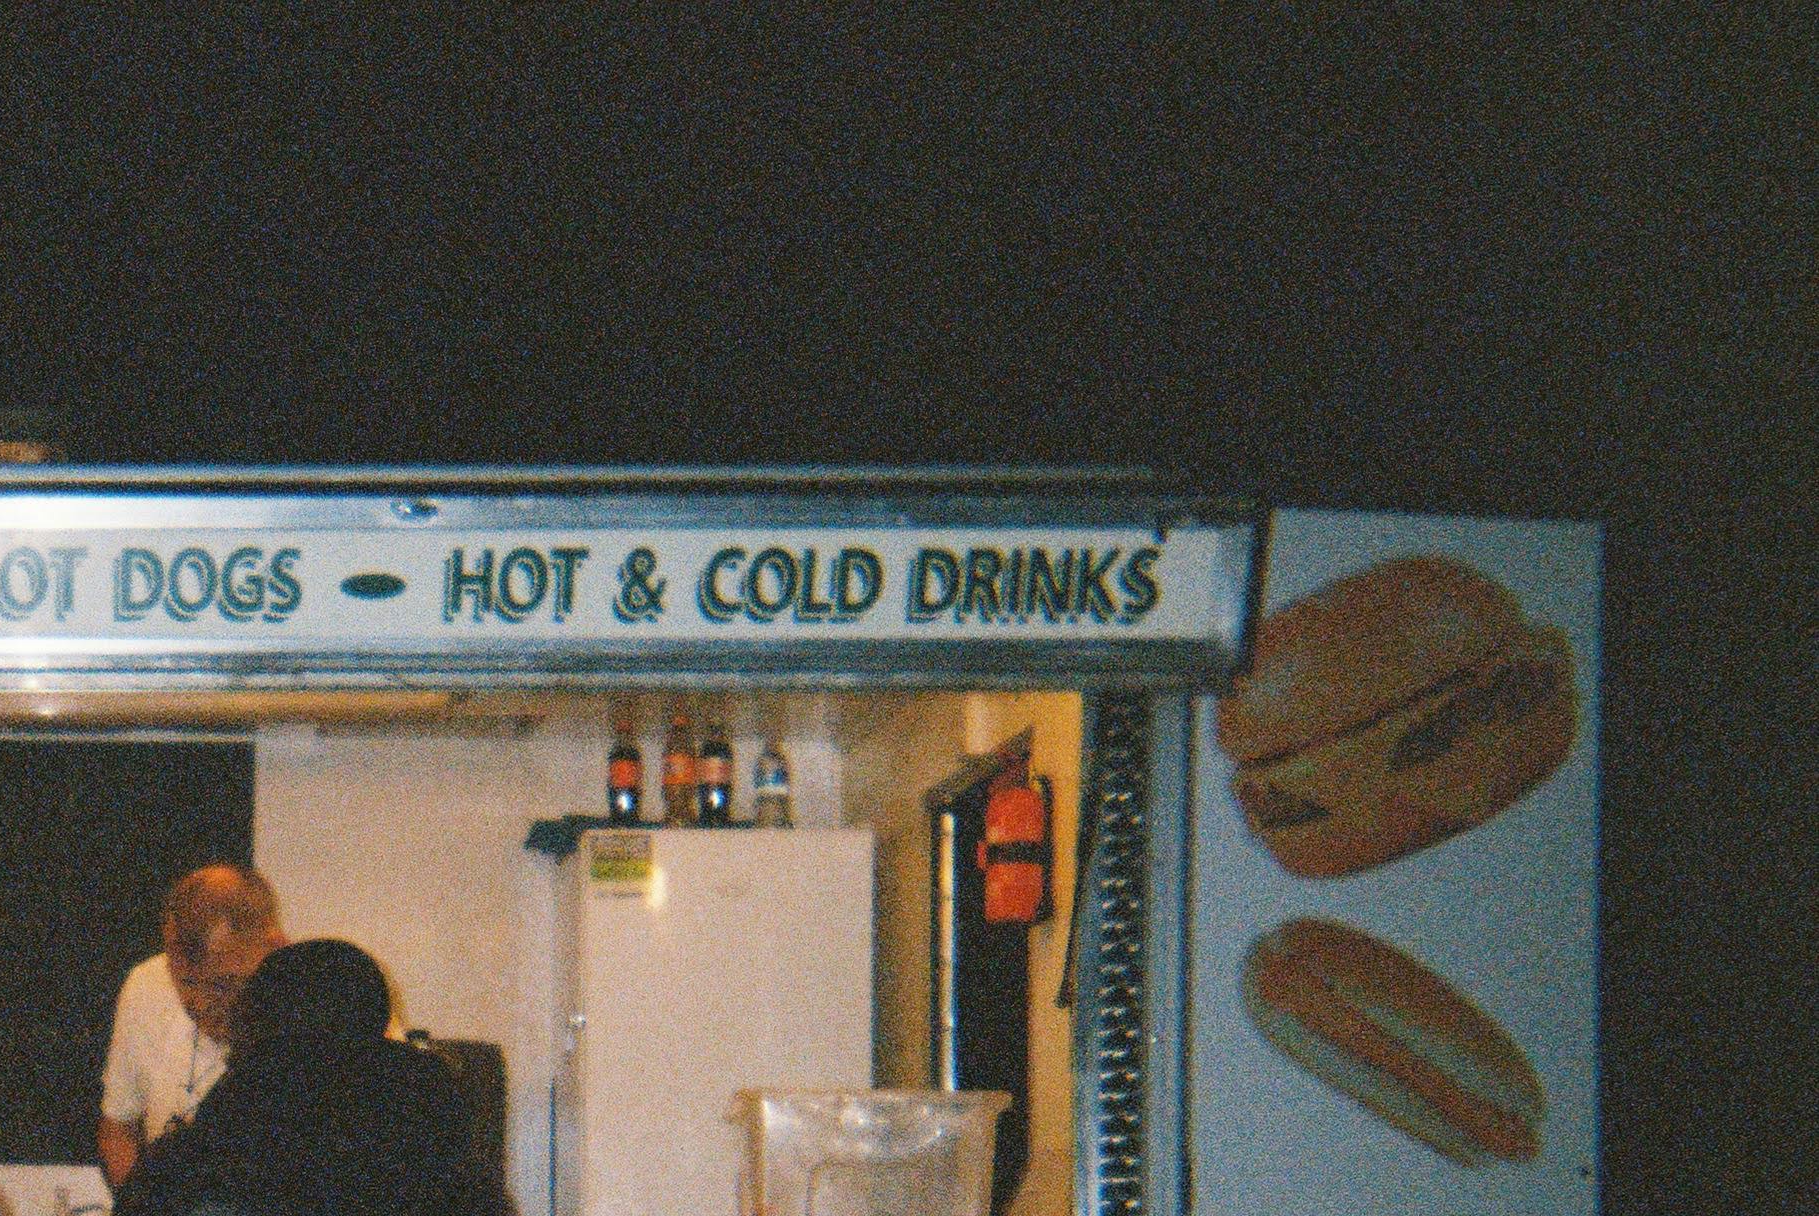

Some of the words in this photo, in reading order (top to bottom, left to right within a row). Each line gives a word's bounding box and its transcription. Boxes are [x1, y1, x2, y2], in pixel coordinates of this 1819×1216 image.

[112, 546, 303, 622] DOGS
[443, 547, 589, 623] HOT
[613, 547, 667, 623] &
[695, 546, 885, 624] COLD
[906, 545, 1164, 625] DRINKS
